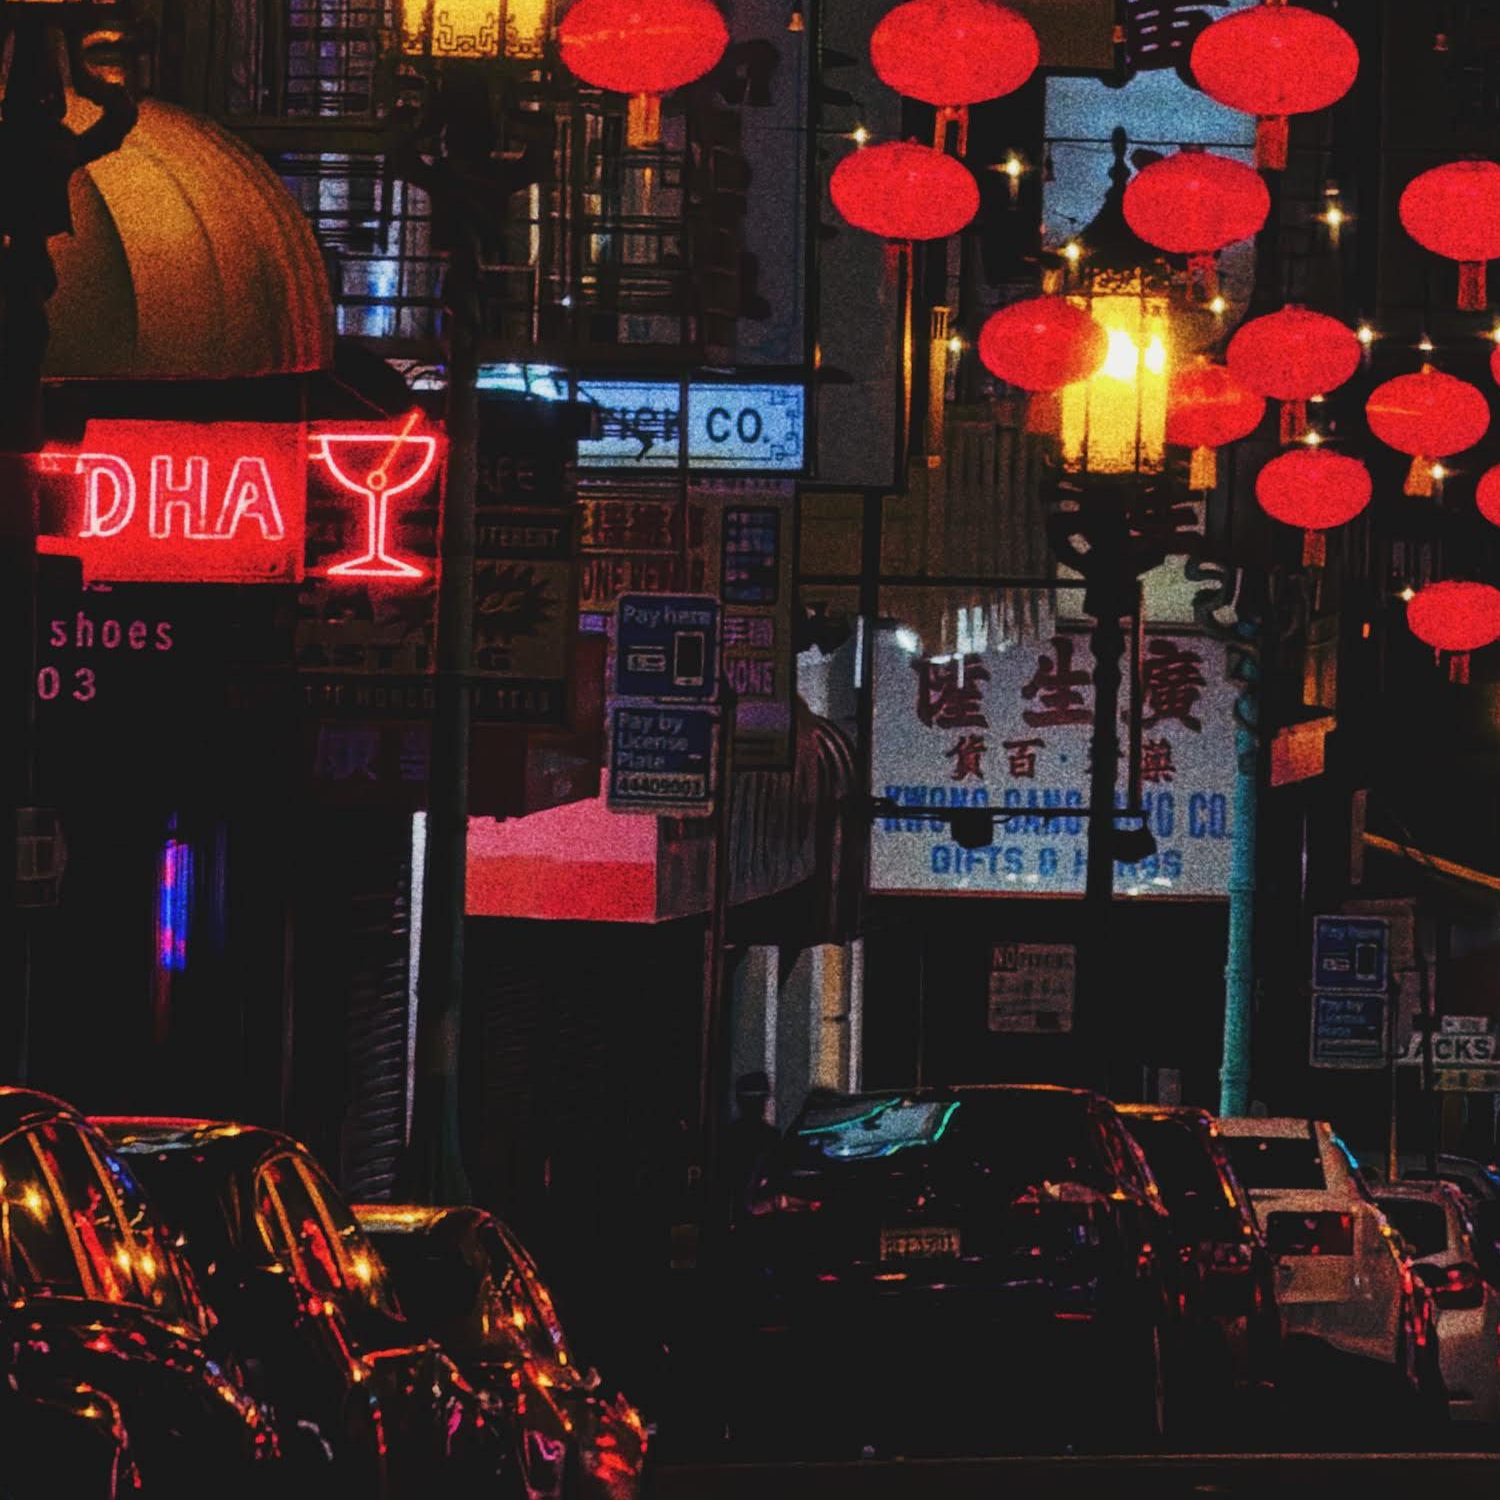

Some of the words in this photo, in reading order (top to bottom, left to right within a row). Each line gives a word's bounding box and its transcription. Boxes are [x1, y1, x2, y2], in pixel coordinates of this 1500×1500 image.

[705, 406, 770, 444] CO.
[77, 452, 286, 541] DHA
[49, 610, 174, 652] shoes
[621, 603, 662, 629] Pay
[663, 605, 712, 628] here
[36, 665, 97, 702] 03
[618, 711, 655, 733] Pay
[657, 711, 685, 733] by
[617, 731, 690, 753] License
[616, 751, 666, 771] Plate
[930, 845, 1025, 875] GIFTS
